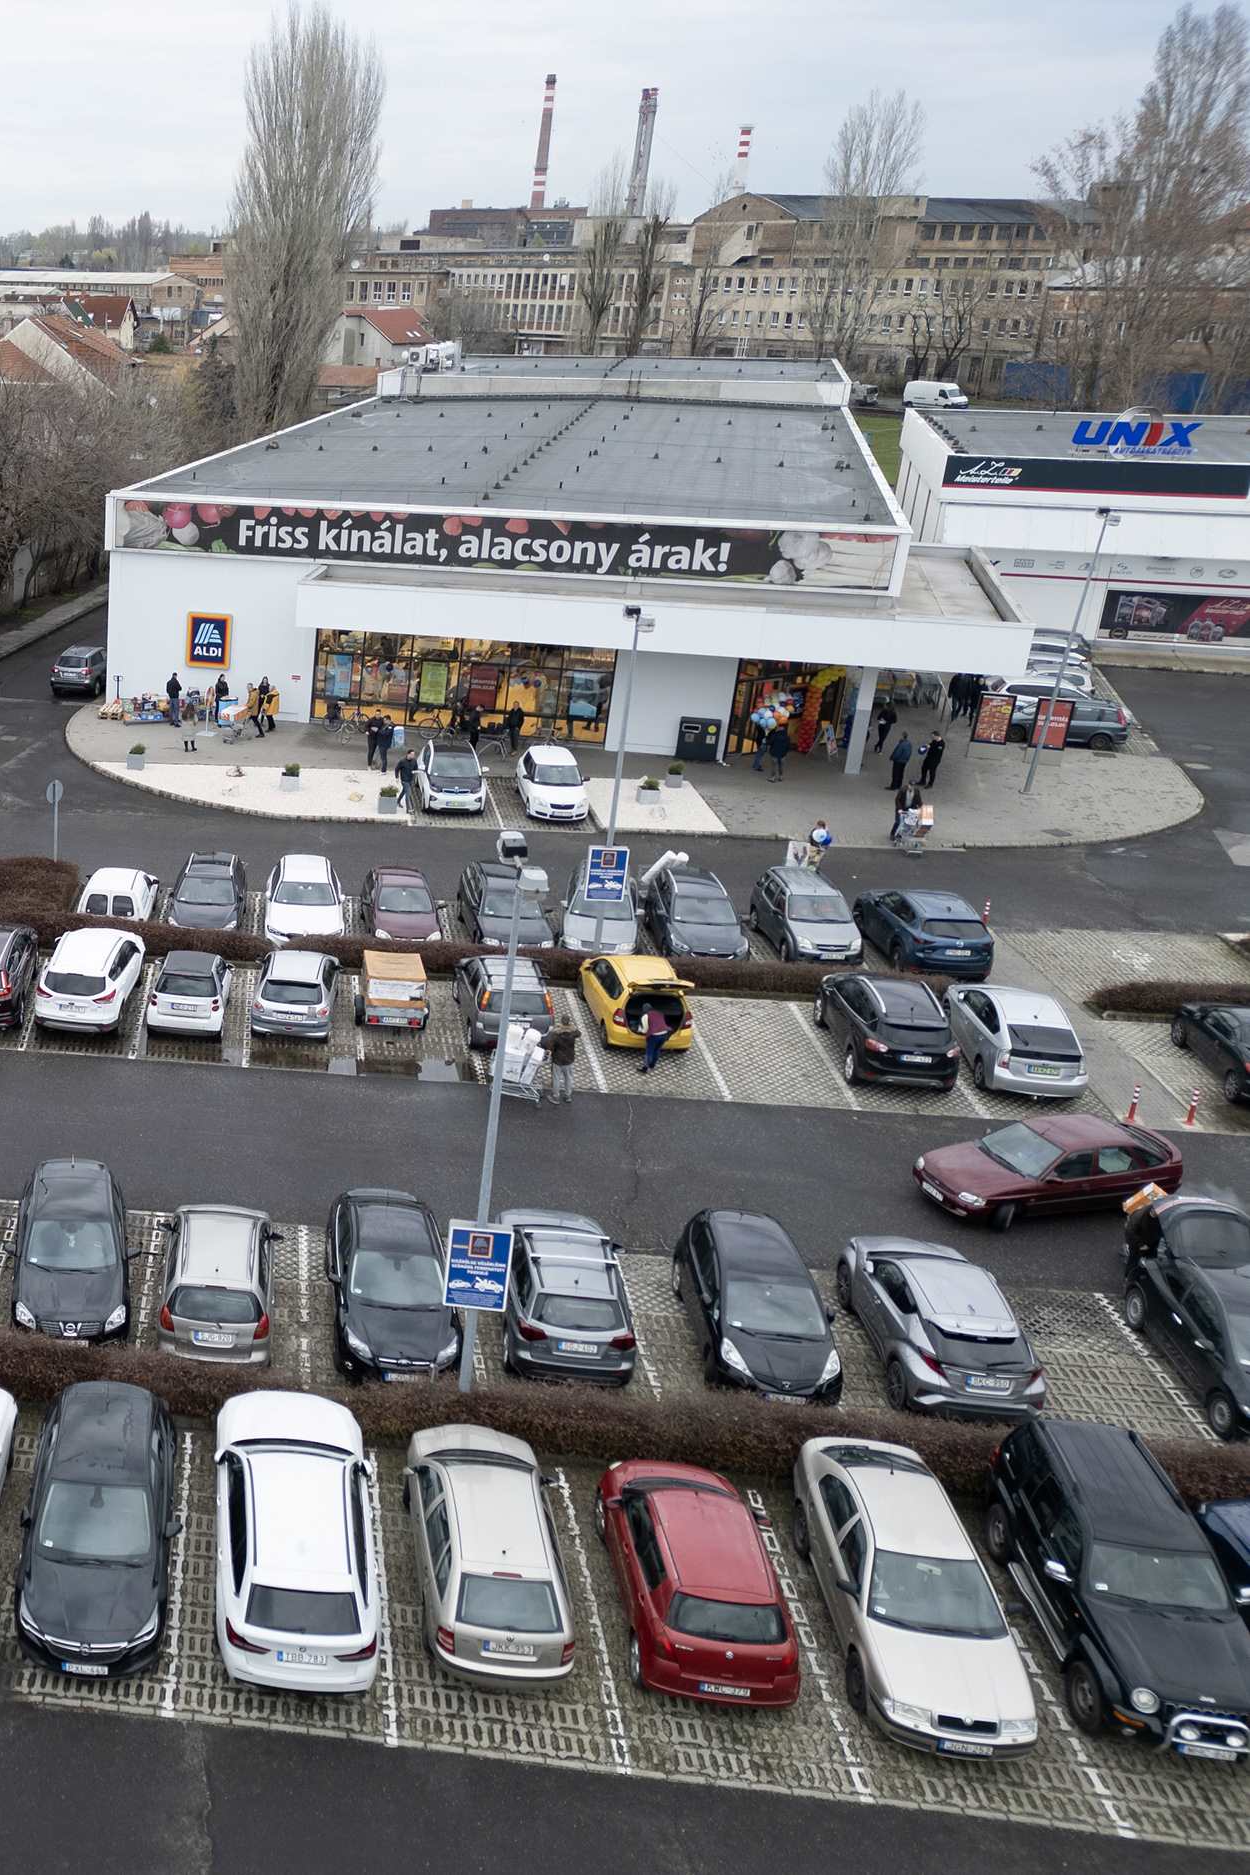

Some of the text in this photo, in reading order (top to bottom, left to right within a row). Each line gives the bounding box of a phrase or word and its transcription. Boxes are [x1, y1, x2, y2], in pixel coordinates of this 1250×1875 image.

[1071, 420, 1205, 448] UNIX
[238, 517, 732, 574] Friss kínálat, alacsony árak!
[193, 645, 223, 657] ALDI
